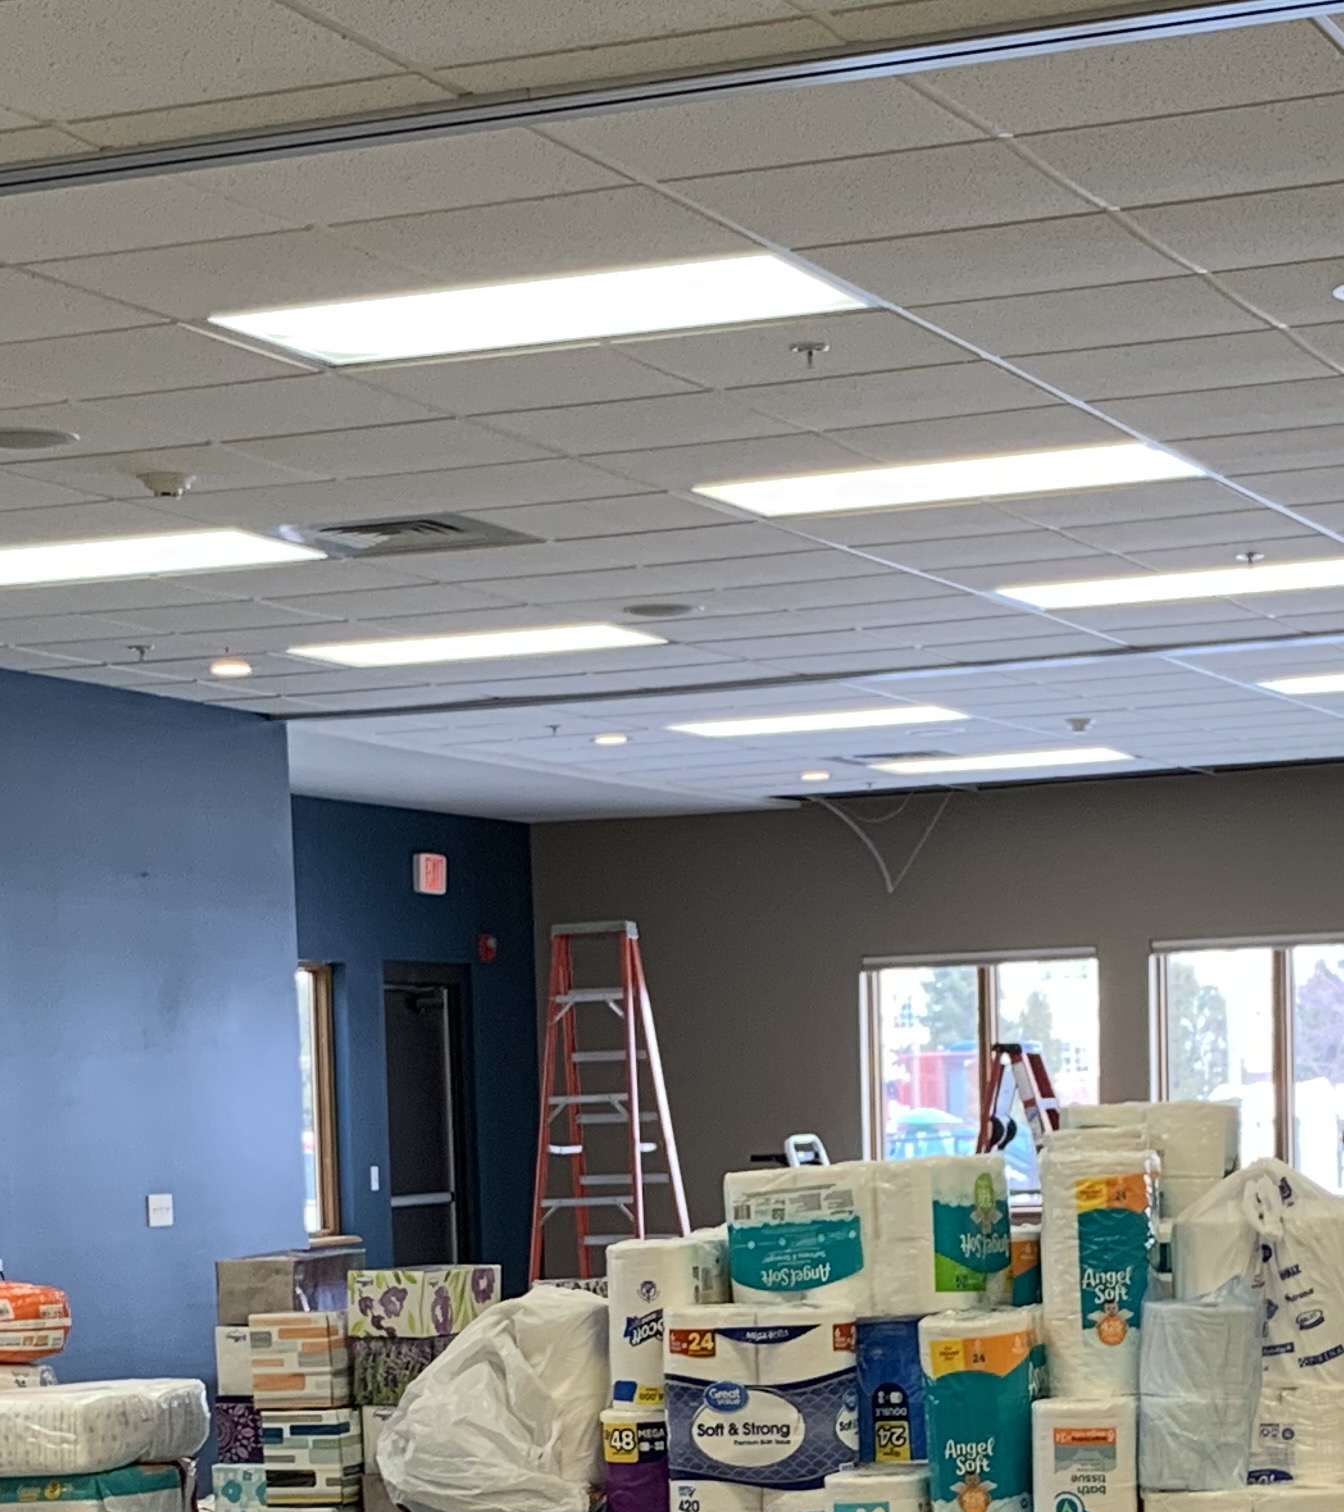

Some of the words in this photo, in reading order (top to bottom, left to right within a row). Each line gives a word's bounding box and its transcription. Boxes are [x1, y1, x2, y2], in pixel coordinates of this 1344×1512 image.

[761, 1269, 789, 1286] Soft
[788, 1262, 831, 1286] Angel
[1082, 1265, 1133, 1289] Angel
[1094, 1283, 1129, 1305] Soft
[688, 1332, 714, 1350] 24
[708, 1388, 741, 1400] Great
[610, 1428, 636, 1451] 48
[638, 1428, 665, 1439] MEGA
[697, 1422, 724, 1437] Soft
[728, 1422, 739, 1437] &
[742, 1422, 791, 1438] Strong
[877, 1425, 908, 1448] 24
[944, 1438, 996, 1460] Angel
[956, 1455, 991, 1476] Soft
[1070, 1474, 1107, 1483] tissue
[1077, 1485, 1107, 1495] bath
